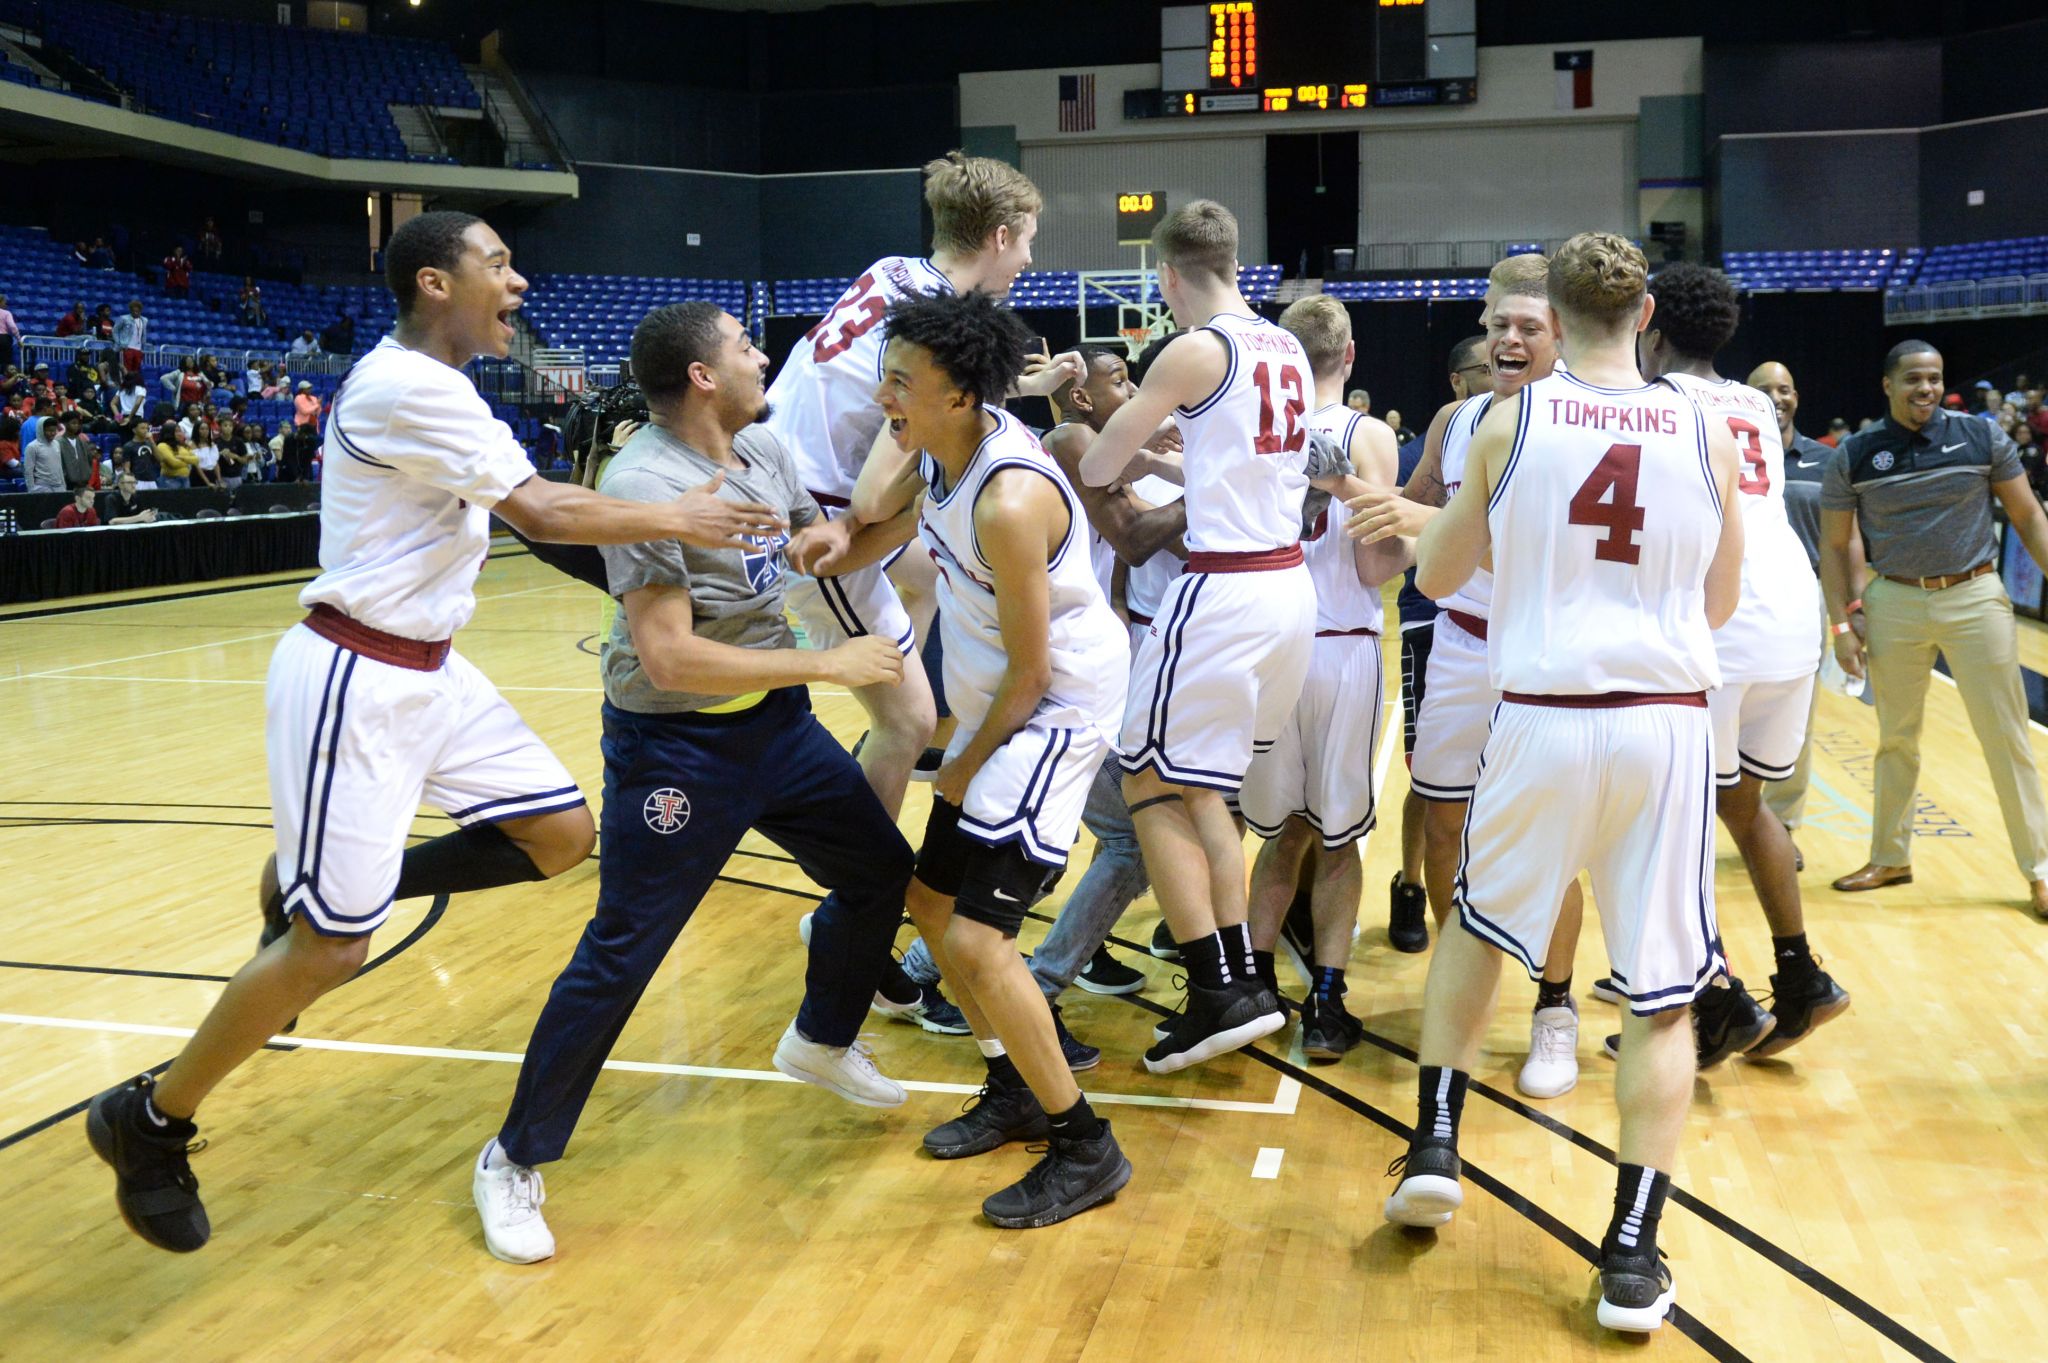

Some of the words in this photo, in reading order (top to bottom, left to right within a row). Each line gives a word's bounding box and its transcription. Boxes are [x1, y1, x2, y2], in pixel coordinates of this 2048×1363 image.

[1119, 195, 1152, 212] 00.0
[1236, 332, 1298, 355] TOMPKINS
[1252, 361, 1306, 455] 12
[1549, 399, 1677, 434] TOMPKINS
[1568, 443, 1645, 565] 4
[655, 795, 683, 826] T
